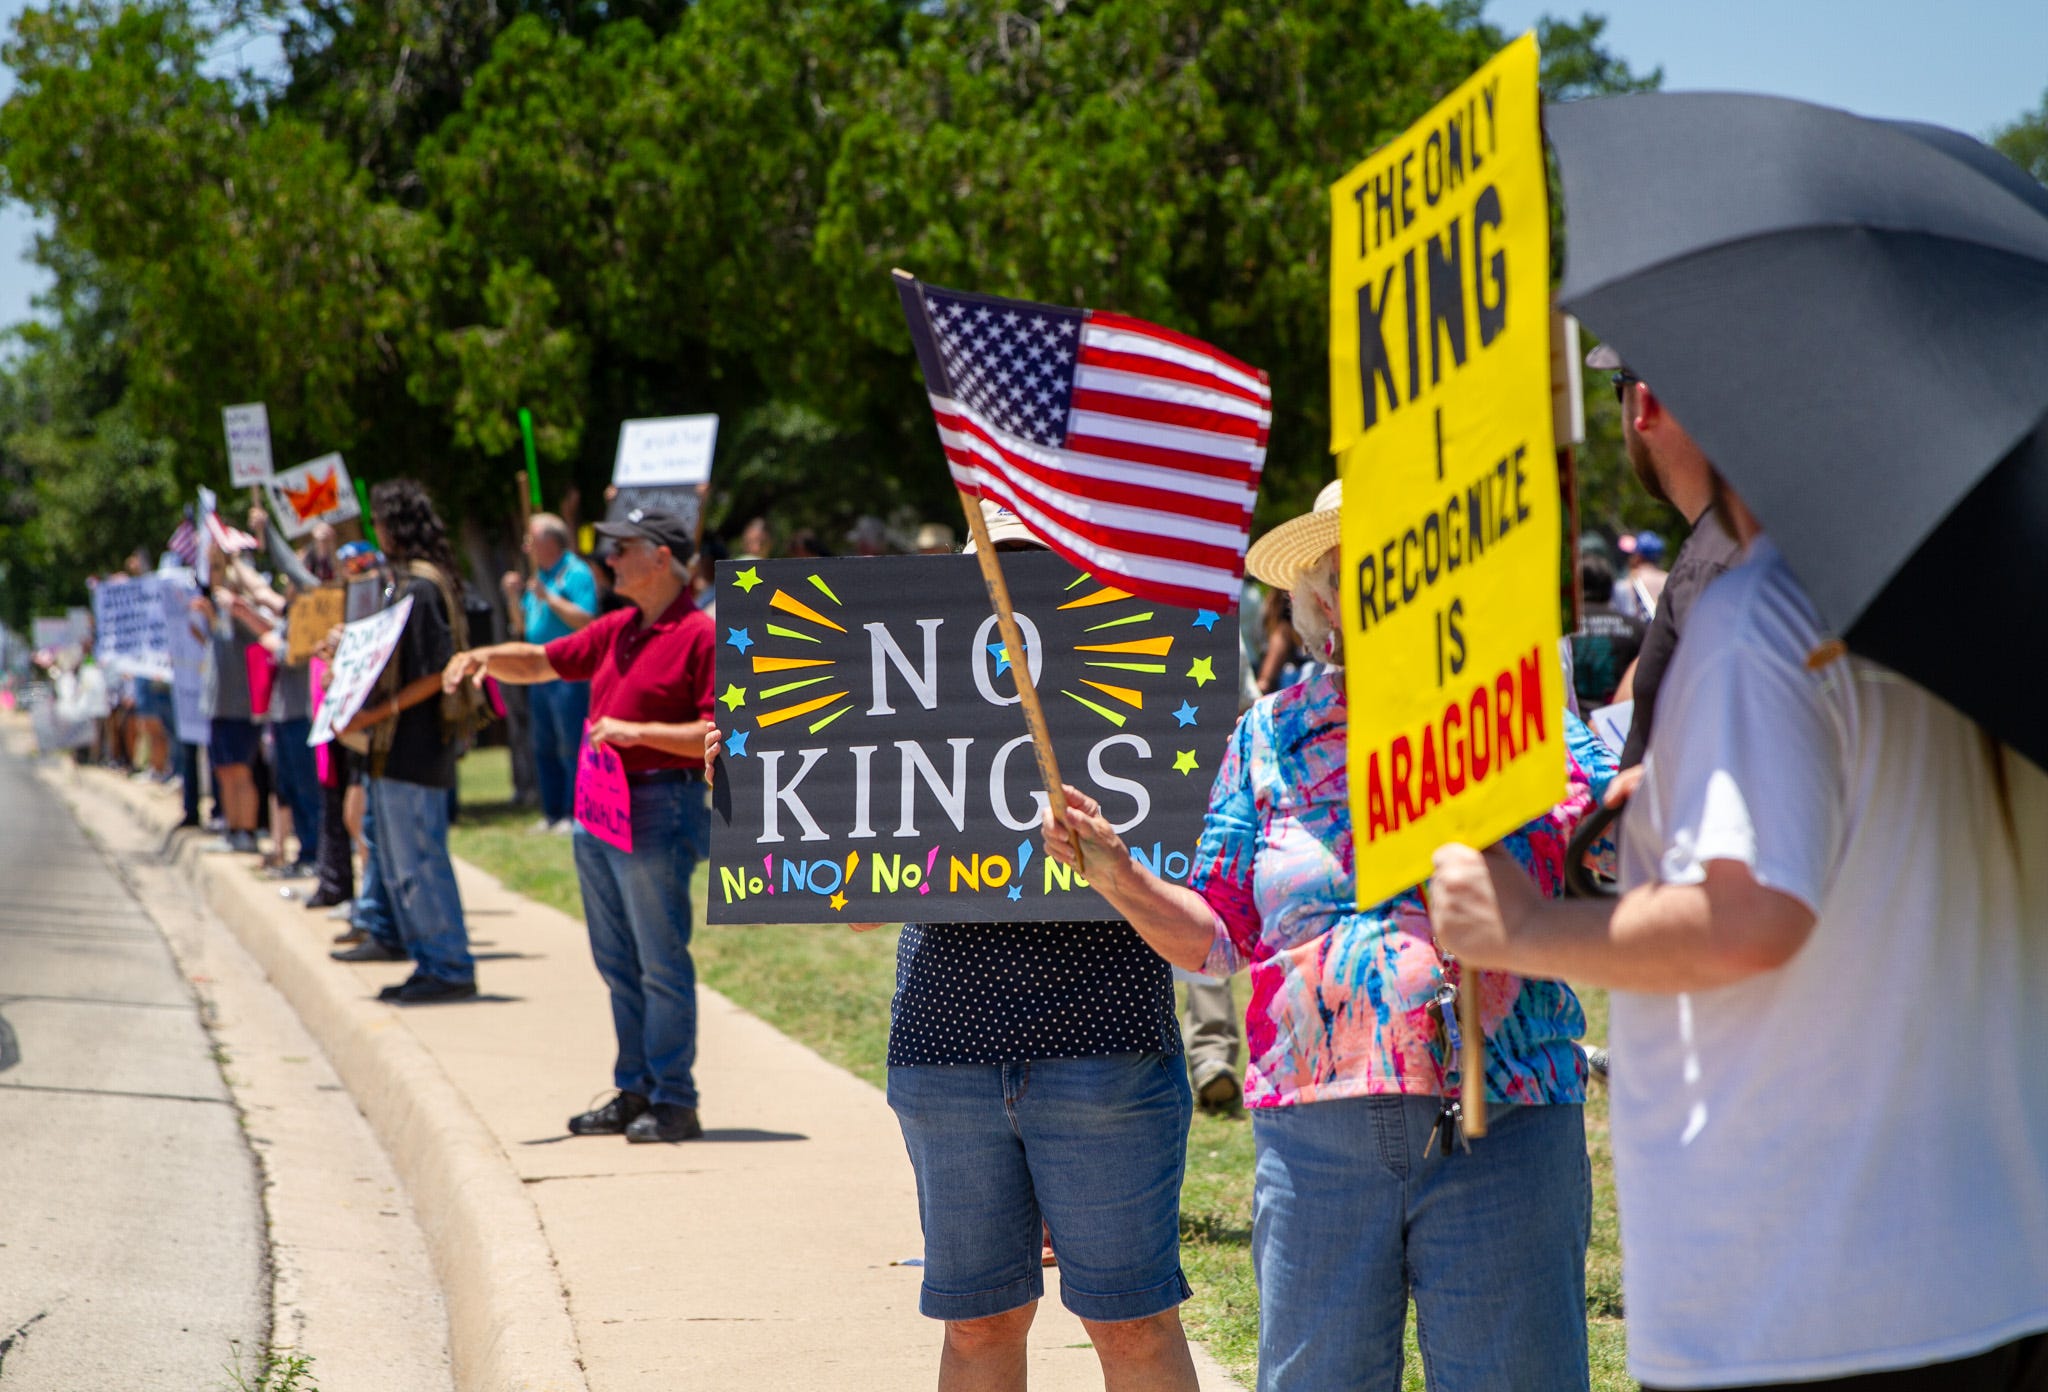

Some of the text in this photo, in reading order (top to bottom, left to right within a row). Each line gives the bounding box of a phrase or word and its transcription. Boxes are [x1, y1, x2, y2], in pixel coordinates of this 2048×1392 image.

[1354, 75, 1500, 259] THE ONLY
[1356, 183, 1508, 433] KING
[1434, 406, 1444, 481] I
[1357, 443, 1530, 632] RECOGNIZE
[862, 610, 1043, 716] NO
[1434, 596, 1467, 687] IS
[756, 733, 1153, 844] KINGS
[1368, 645, 1547, 844] ARAGORN
